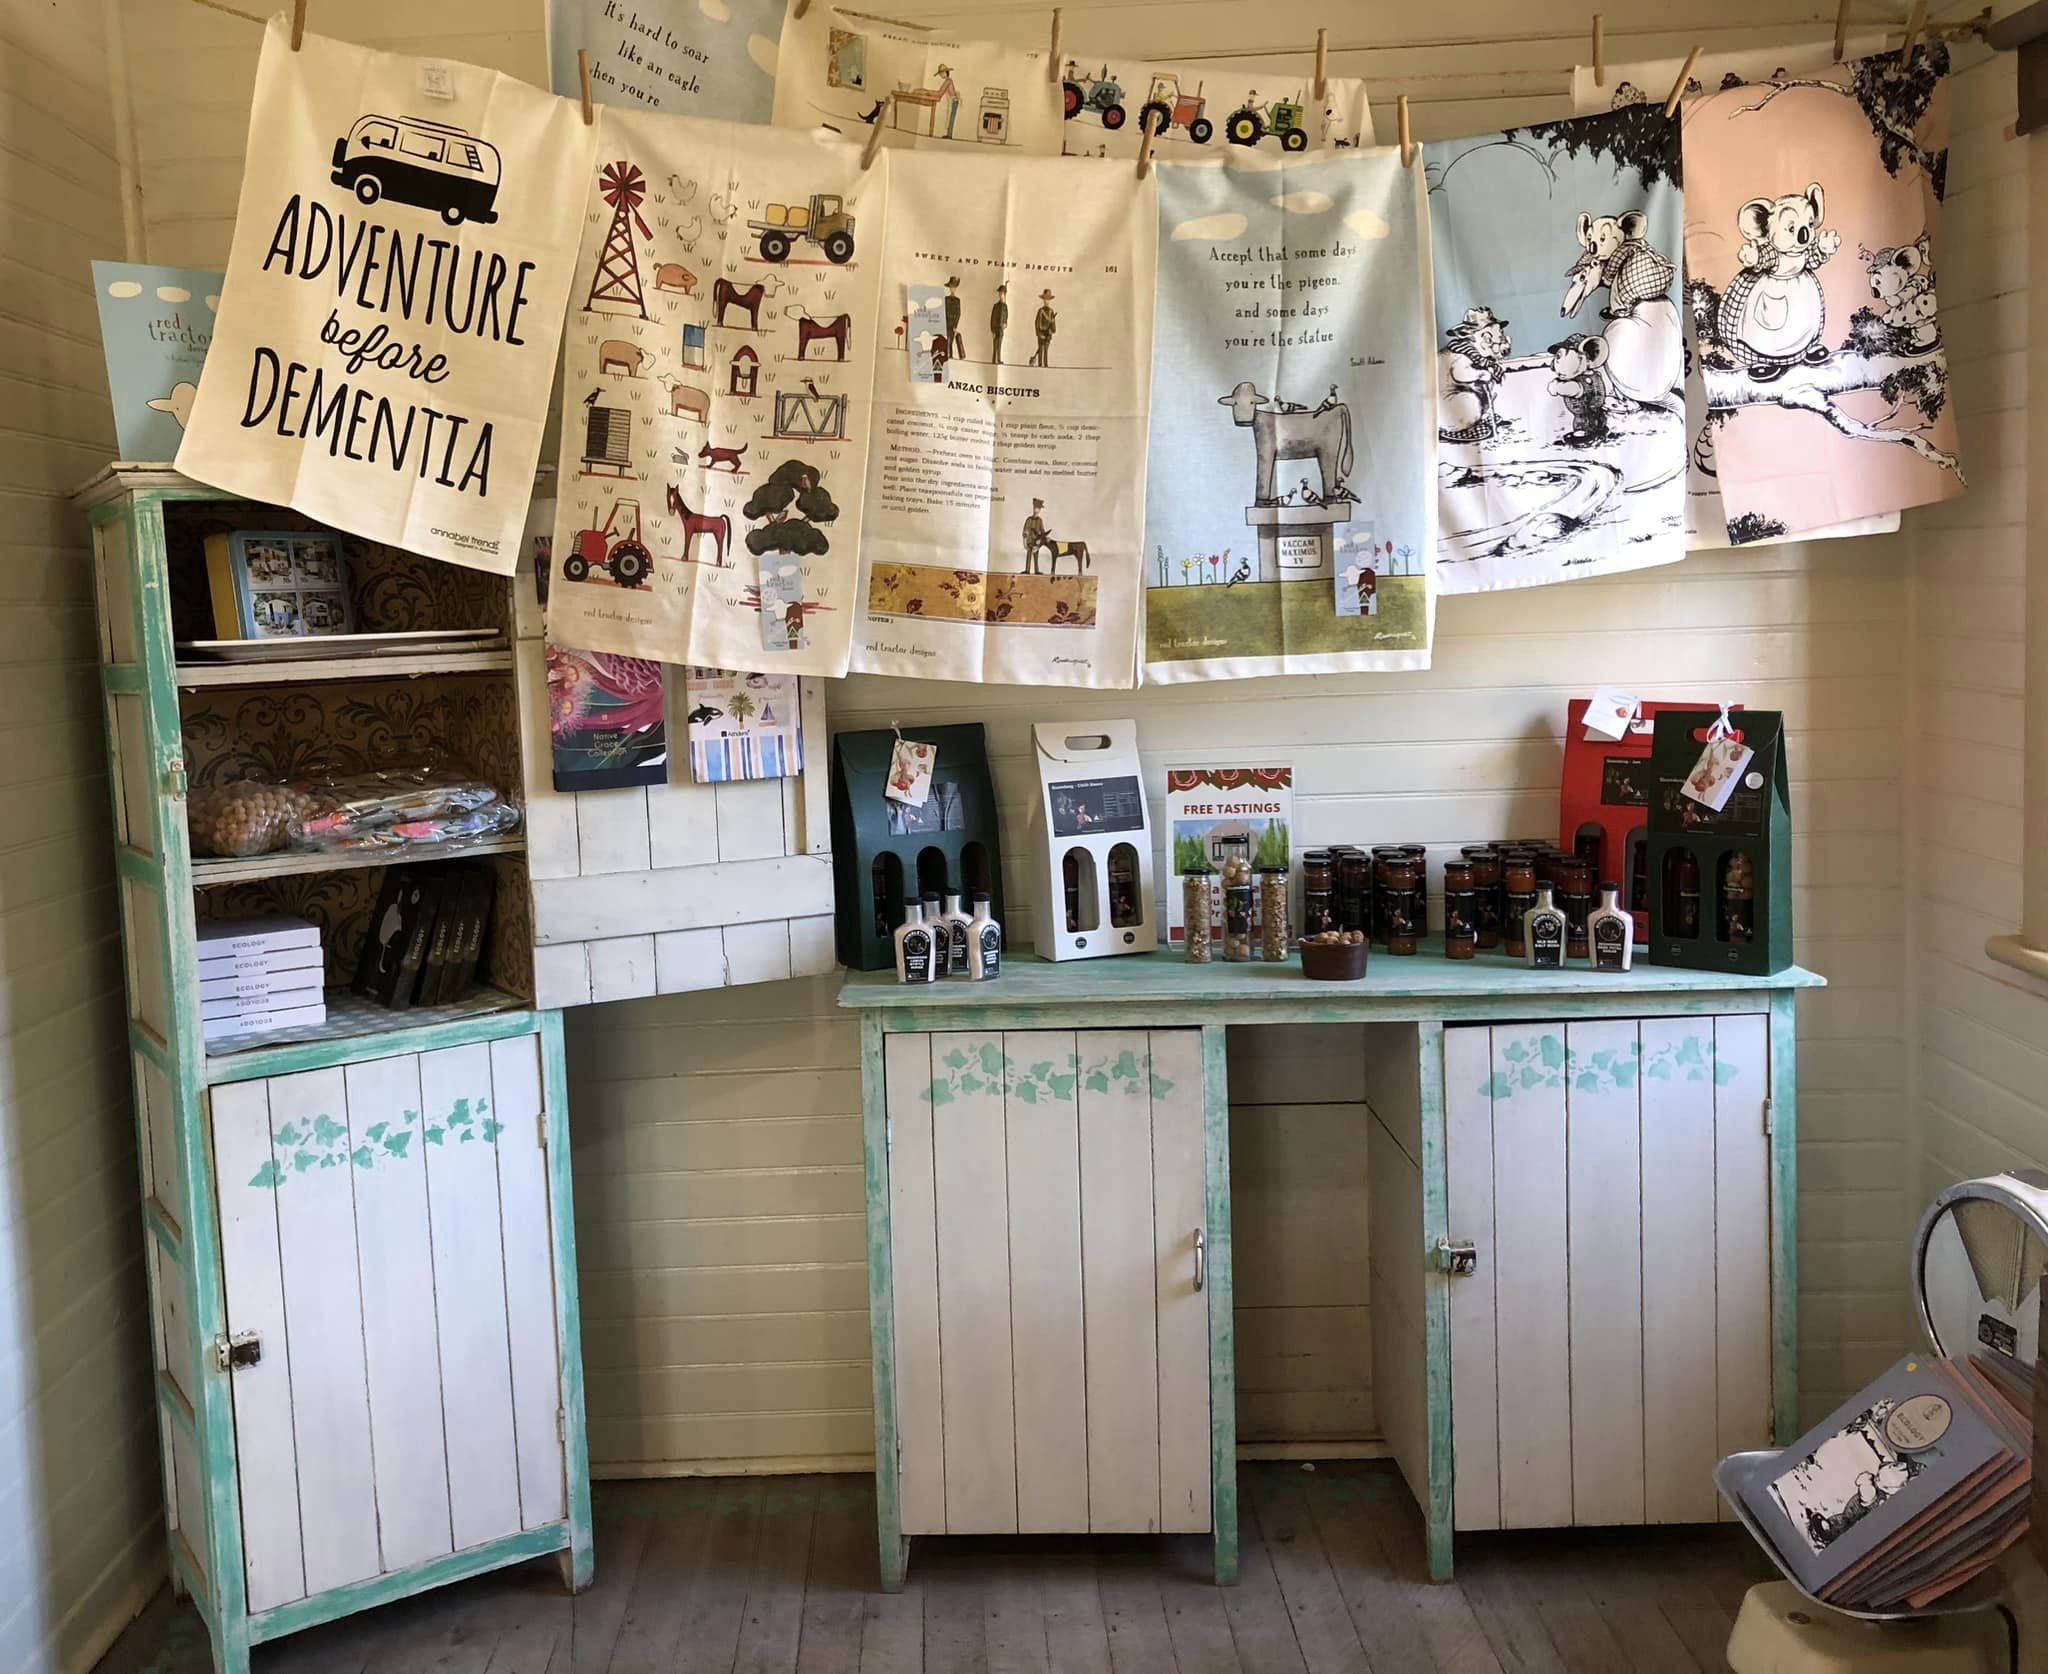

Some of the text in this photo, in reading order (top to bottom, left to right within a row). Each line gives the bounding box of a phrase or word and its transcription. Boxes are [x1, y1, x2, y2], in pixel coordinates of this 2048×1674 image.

[604, 0, 710, 64] It's hard to soar
[618, 40, 700, 94] like an eagle
[590, 61, 660, 107] hen you're
[1209, 241, 1357, 265] Accept that some days
[262, 194, 537, 345] ADVENTURE
[915, 252, 950, 262] SWEET
[958, 257, 980, 266] AND
[1025, 263, 1074, 273] BISCUITS
[1105, 265, 1118, 274] 161
[1225, 272, 1266, 292] you're
[1270, 274, 1293, 291] the
[1235, 301, 1329, 319] and some days
[157, 313, 180, 329] red
[320, 308, 450, 383] before
[1224, 328, 1334, 349] you're the statue
[947, 380, 1041, 398] ANZAC BISCUITS
[240, 346, 493, 497] DEMENTIA
[430, 527, 470, 543] annabel
[1282, 547, 1317, 556] MAXIMUS
[866, 641, 936, 658] red tractor designs
[593, 732, 618, 740] Native
[1183, 802, 1281, 815] FREE TASTINGS
[232, 940, 266, 950] ECOLOGY
[235, 960, 269, 970] ECOLOGY
[236, 983, 270, 993] ECOLOGY
